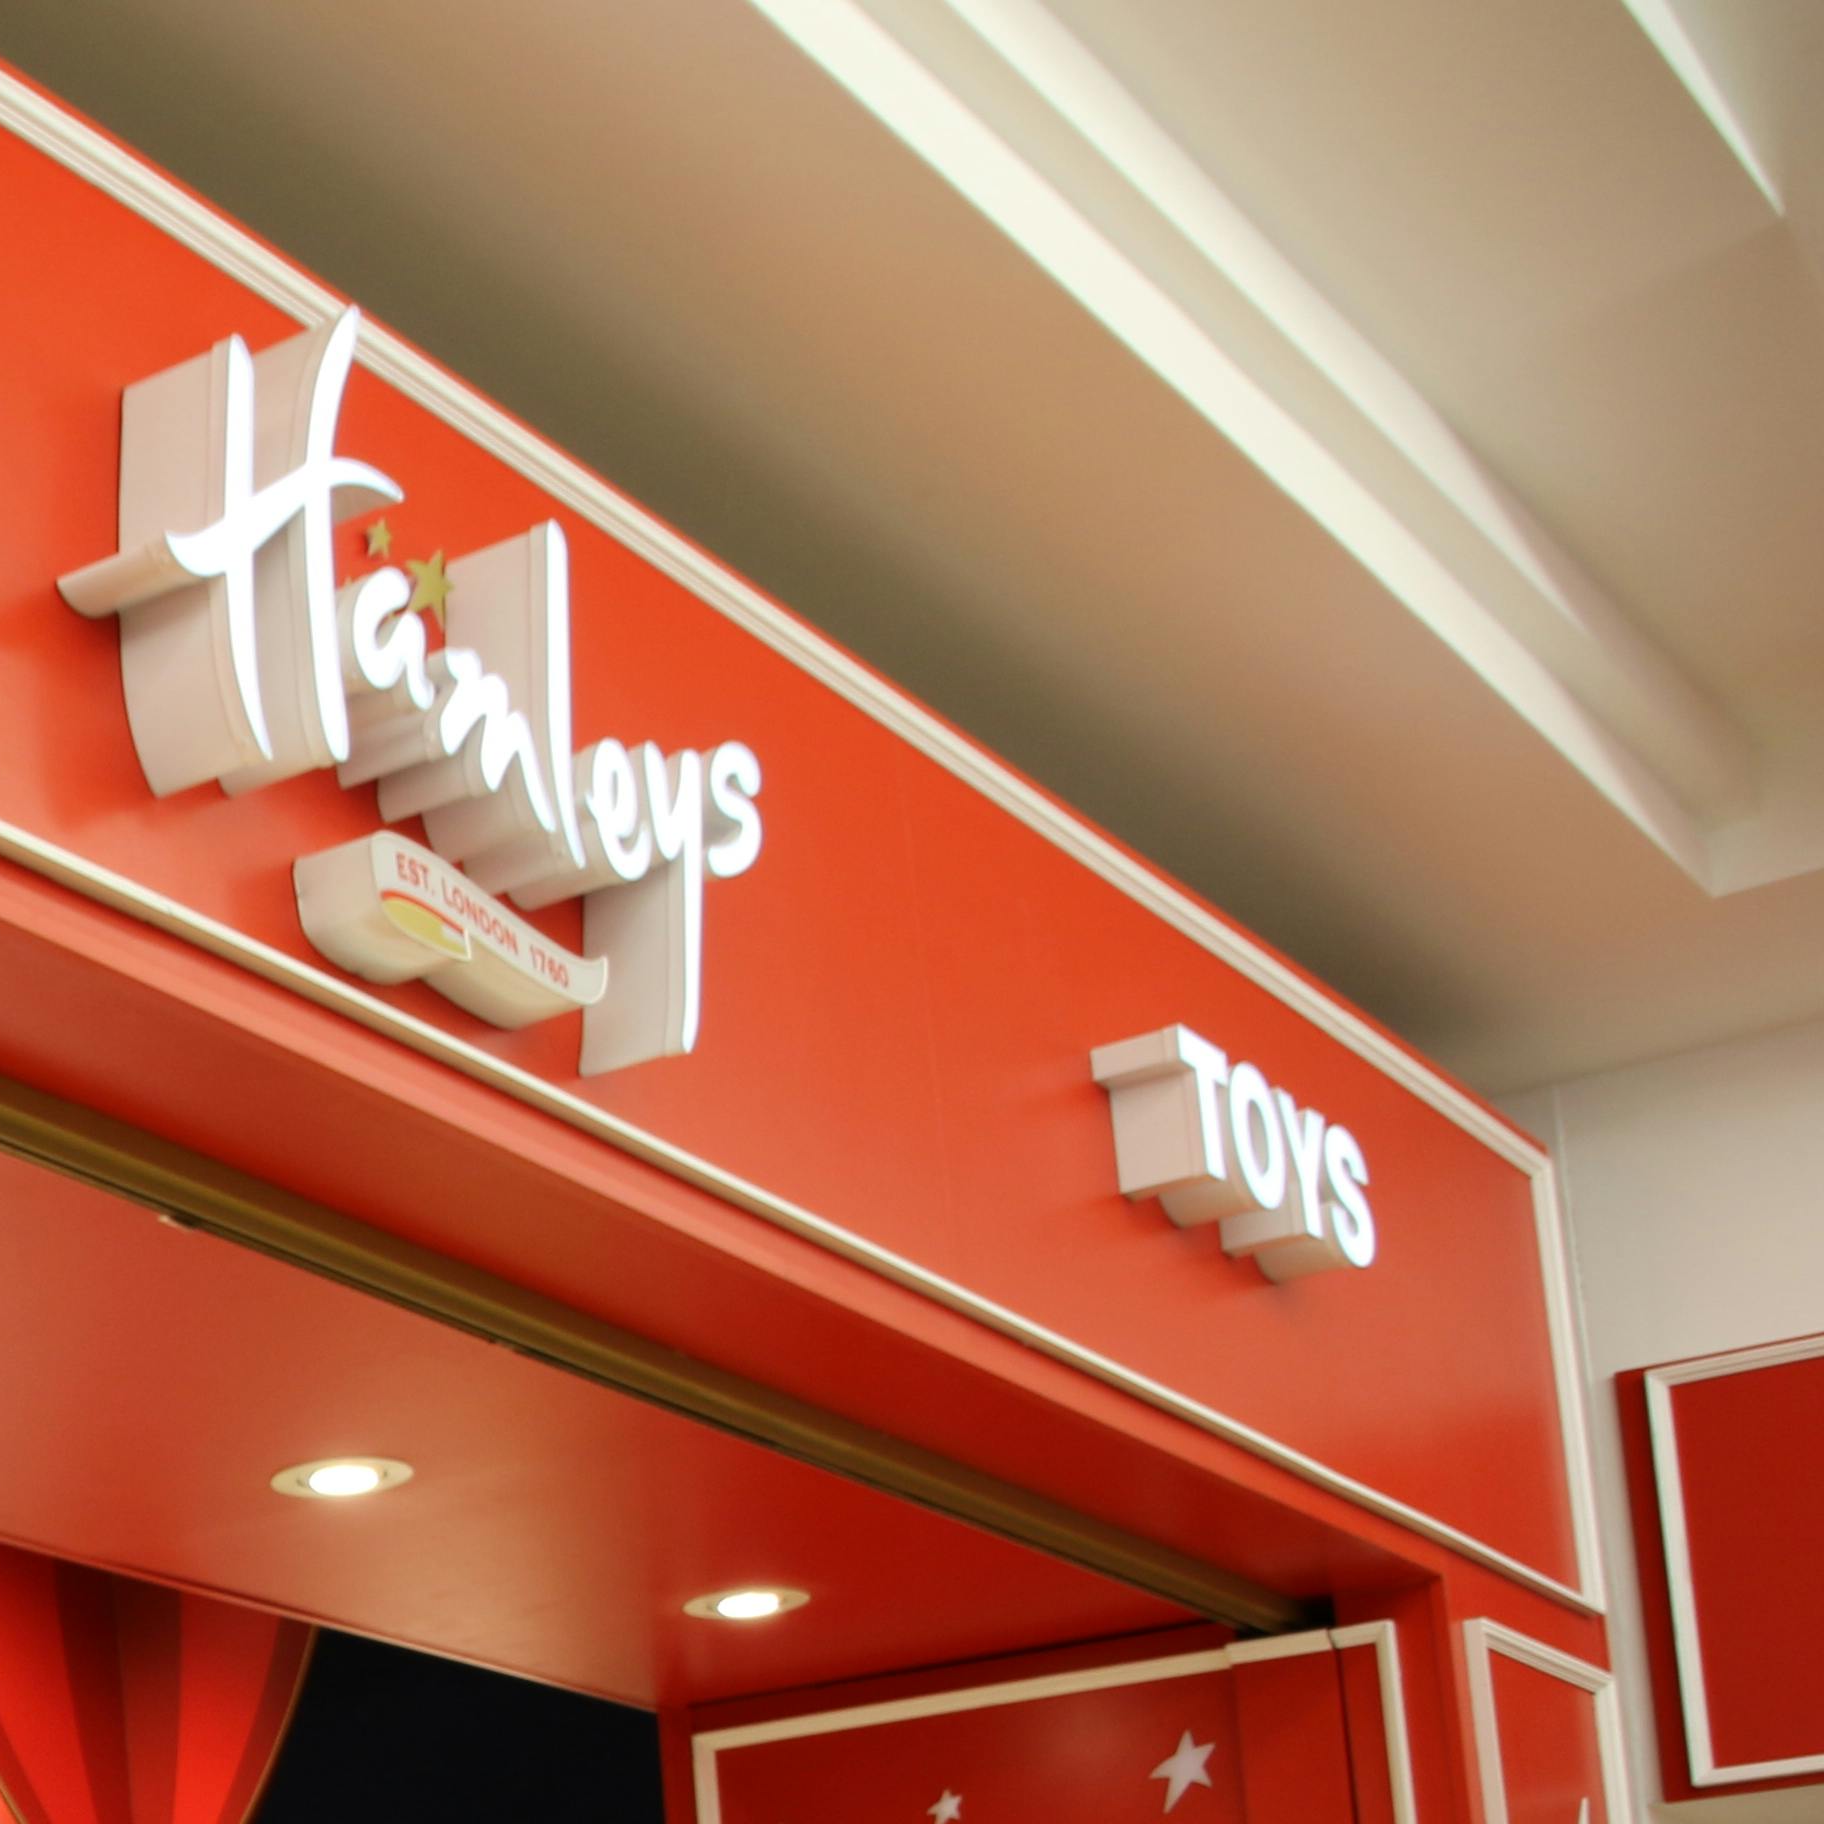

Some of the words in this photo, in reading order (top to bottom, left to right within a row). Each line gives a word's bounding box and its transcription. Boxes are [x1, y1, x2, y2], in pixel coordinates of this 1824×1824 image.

[164, 304, 762, 1056] Hamleys
[396, 852, 436, 896] EST.
[441, 876, 519, 955] LONDON
[1176, 1023, 1375, 1268] TOYS
